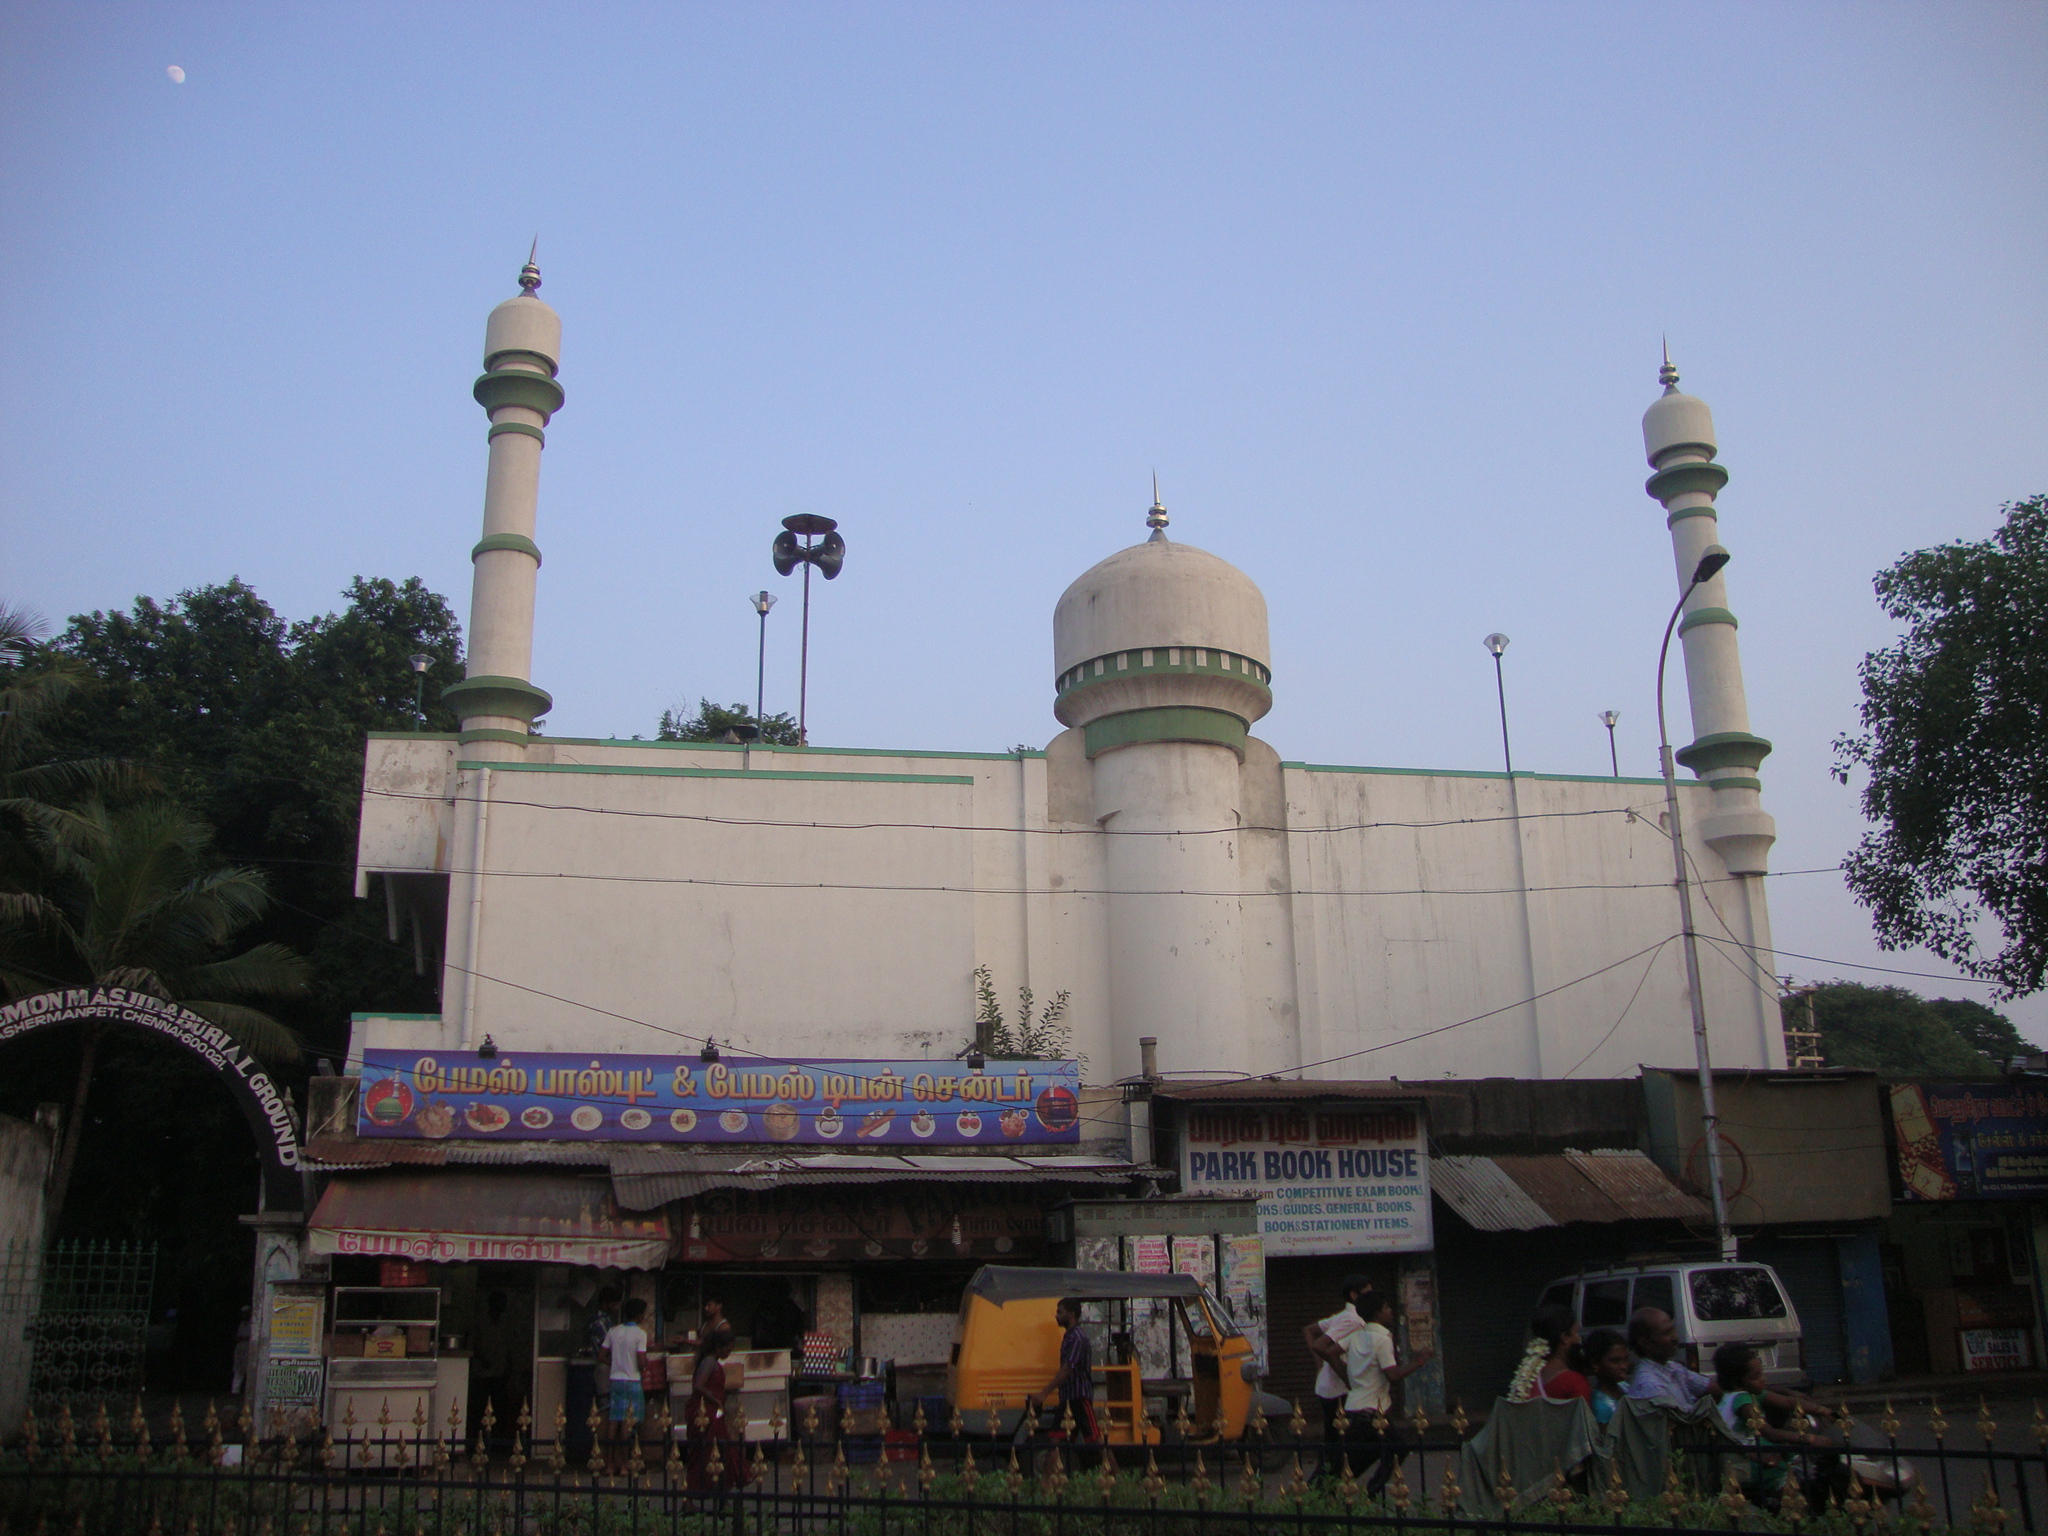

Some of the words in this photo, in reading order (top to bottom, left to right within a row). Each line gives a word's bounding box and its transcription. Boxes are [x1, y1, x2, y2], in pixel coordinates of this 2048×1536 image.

[160, 1002, 178, 1022] &
[176, 1008, 254, 1078] BURIAL
[250, 1072, 298, 1167] GROUND
[412, 1056, 529, 1095] பேமஸ்
[671, 1064, 698, 1098] &
[704, 1062, 817, 1101] பேமஸ்
[822, 1066, 906, 1109] டிபன்
[912, 1067, 1034, 1102] சென்டர்
[1190, 1151, 1258, 1181] PARK
[1263, 1150, 1333, 1181] BOOK
[1338, 1148, 1418, 1179] HOUSE
[1276, 1186, 1353, 1199] COMPETITIVE
[1356, 1185, 1387, 1198] EXAM
[1326, 1201, 1374, 1215] GENERAL
[1302, 1218, 1372, 1232] STATIONERY
[336, 1231, 456, 1258] பேமஸ்
[1987, 1340, 2011, 1354] SALES
